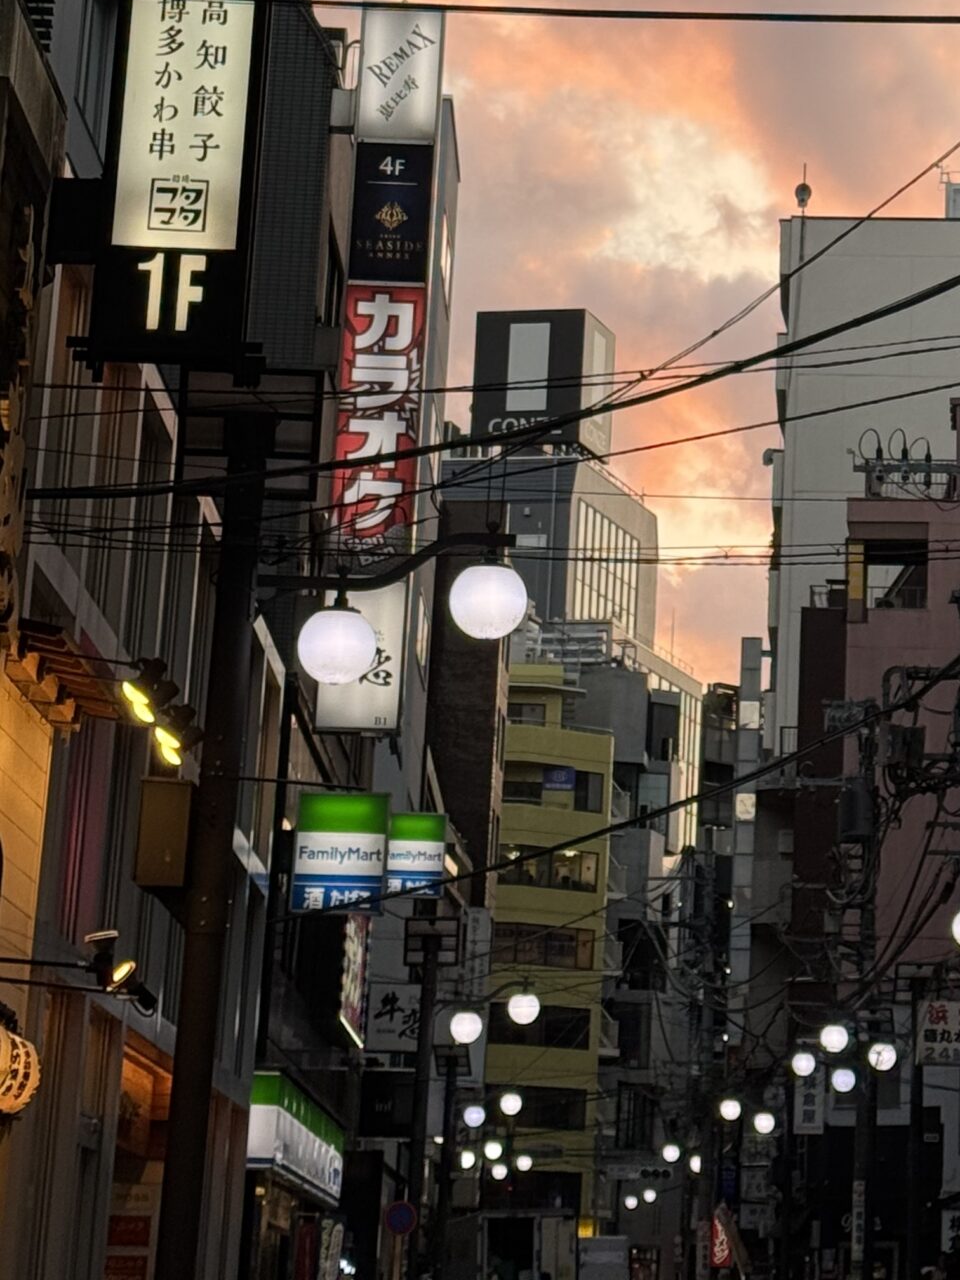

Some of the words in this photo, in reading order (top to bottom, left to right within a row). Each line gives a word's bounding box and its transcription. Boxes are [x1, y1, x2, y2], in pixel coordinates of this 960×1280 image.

[367, 24, 436, 88] REMAX
[379, 156, 405, 176] 4F
[356, 240, 424, 251] SEASIDE
[138, 253, 206, 331] 1F
[344, 294, 414, 530] カラオケ
[374, 716, 388, 726] B1
[299, 845, 383, 865] FamilyMart
[303, 887, 326, 910] 酒
[330, 888, 372, 909] たばこ
